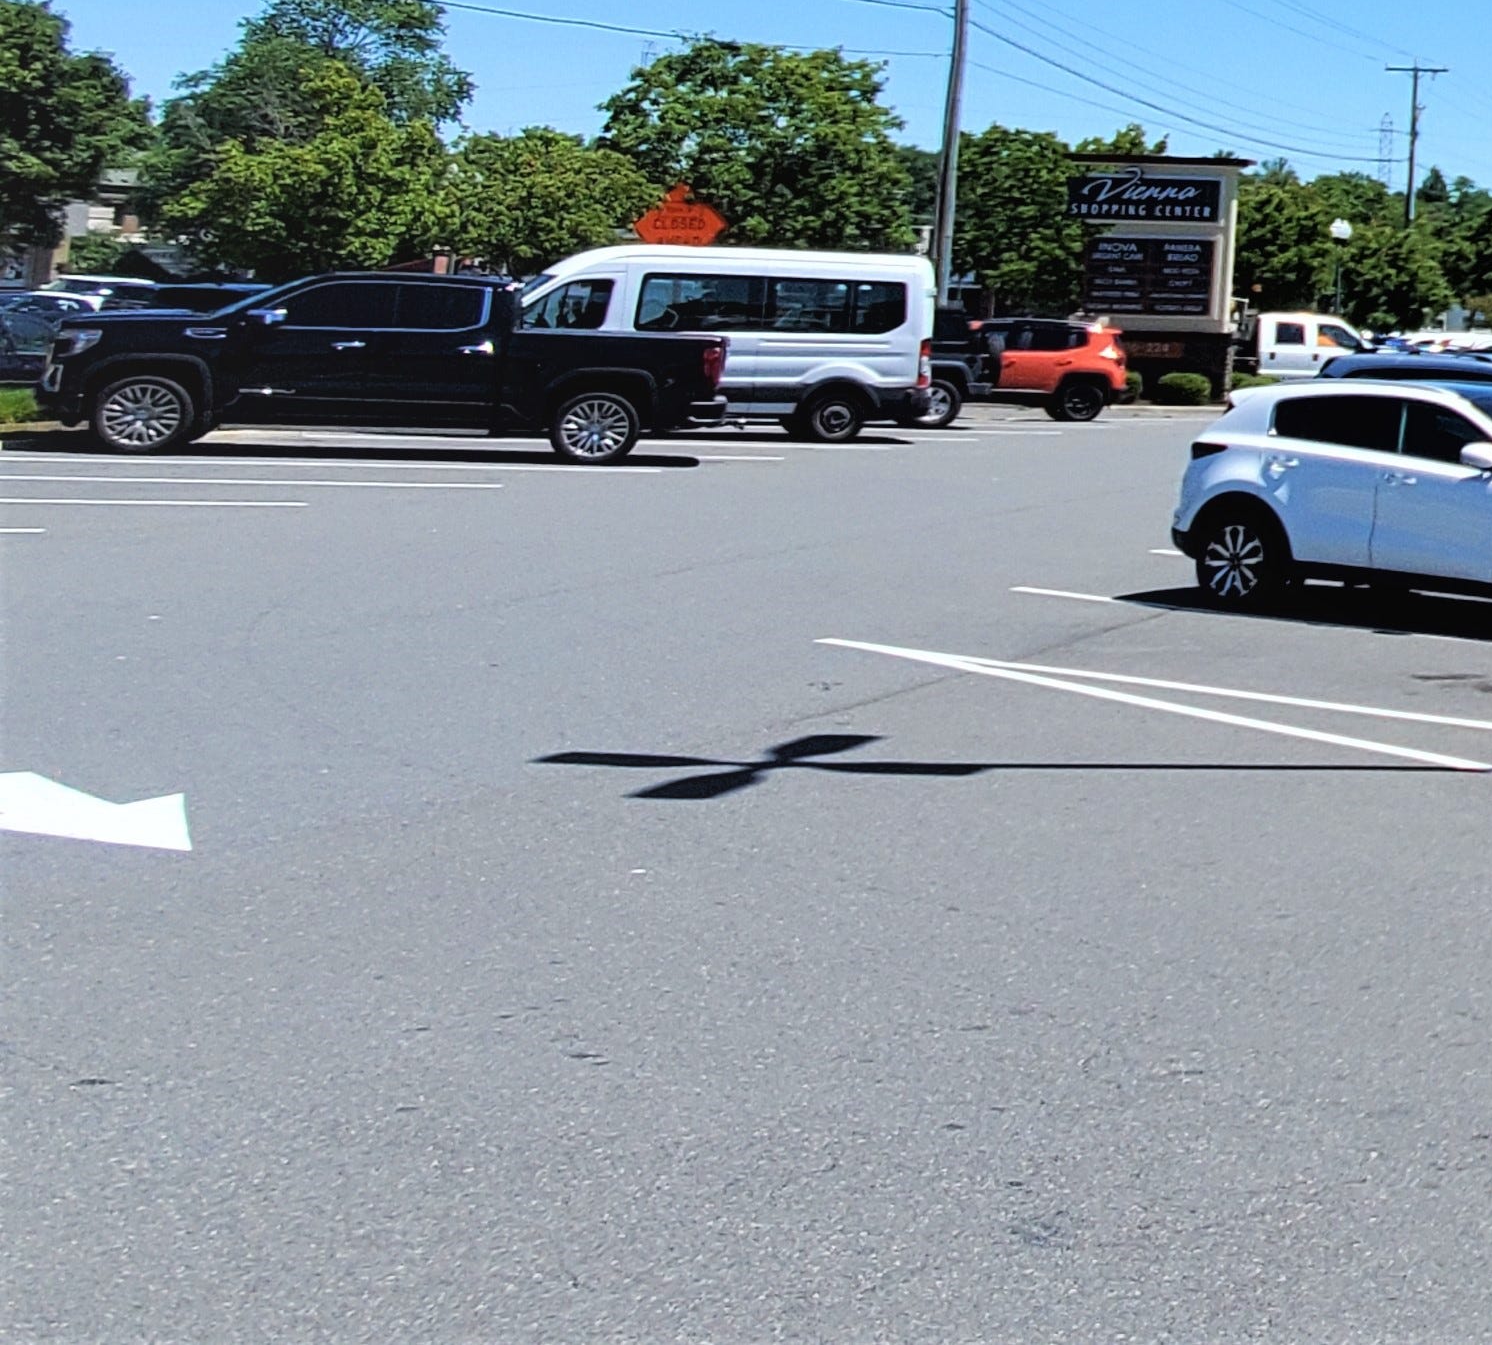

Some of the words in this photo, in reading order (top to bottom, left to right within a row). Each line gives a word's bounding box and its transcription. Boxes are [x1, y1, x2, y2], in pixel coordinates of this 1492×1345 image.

[1081, 167, 1201, 202] Vienna
[1070, 203, 1148, 216] SHOPPING
[1154, 205, 1211, 218] CENTER
[653, 217, 706, 230] CLOSED
